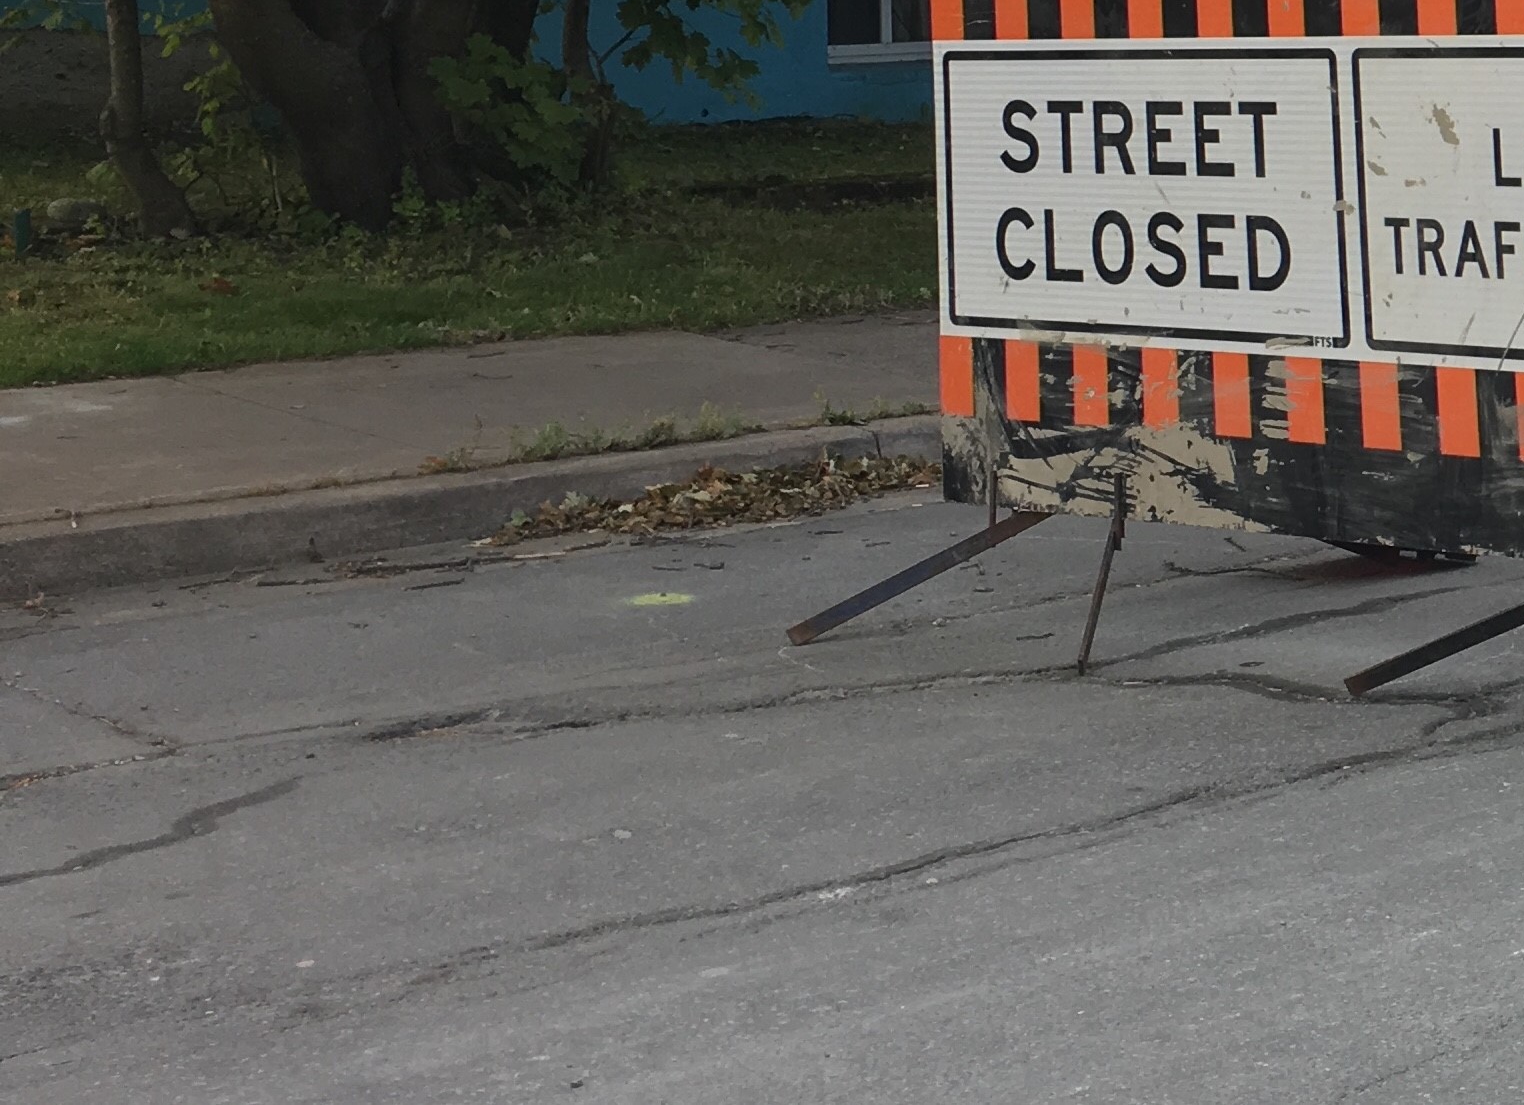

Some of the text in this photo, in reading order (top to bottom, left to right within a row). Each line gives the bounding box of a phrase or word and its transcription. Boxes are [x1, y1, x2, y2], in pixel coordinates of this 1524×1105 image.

[999, 99, 1278, 178] STREET
[995, 206, 1292, 292] CLOSED
[1314, 336, 1333, 348] FTS
